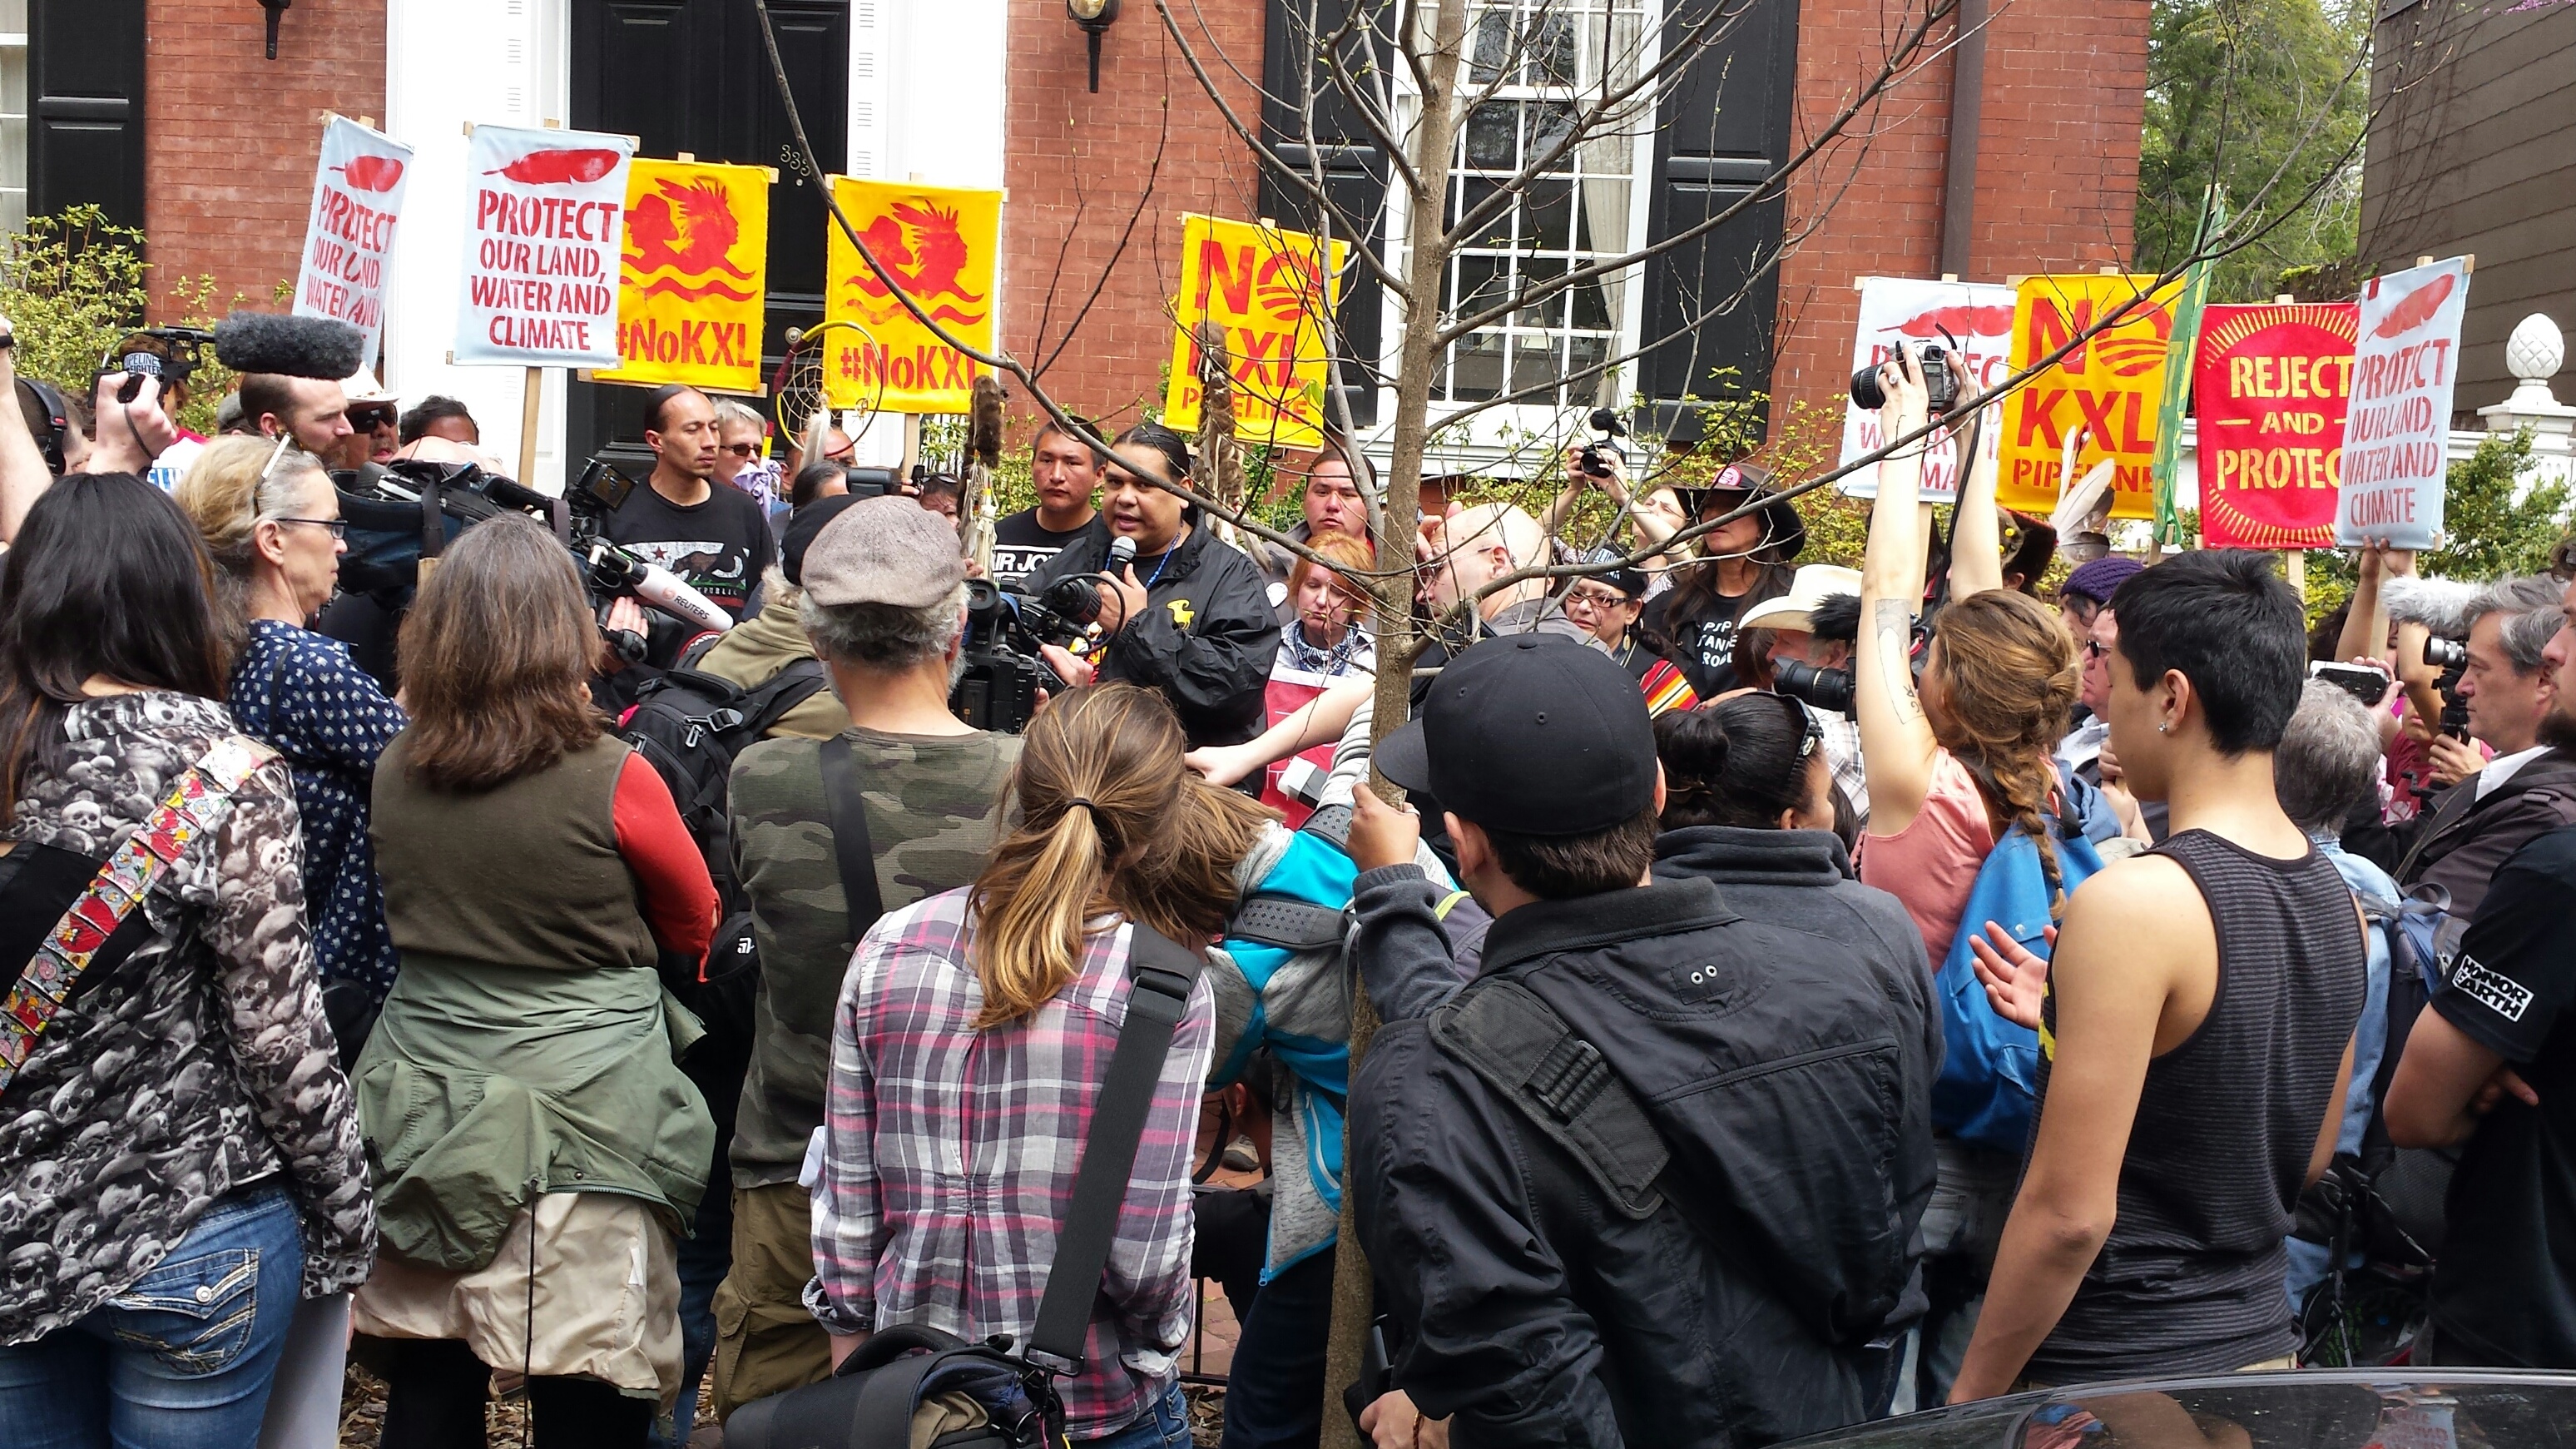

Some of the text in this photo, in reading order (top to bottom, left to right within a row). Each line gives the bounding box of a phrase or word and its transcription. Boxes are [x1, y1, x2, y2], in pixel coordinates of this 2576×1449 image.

[478, 189, 618, 243] PROTECT
[314, 236, 343, 276] OUR
[480, 239, 606, 284] OUR LAND,
[306, 275, 380, 328] WATER AND
[471, 275, 610, 315] WATER AND
[1195, 240, 1321, 321] NO
[489, 315, 591, 350] CLIMATE
[2029, 298, 2172, 377] NO
[2230, 355, 2355, 398] REJECT
[2358, 339, 2450, 400] PROTECT
[2017, 388, 2153, 454] KXL
[2259, 412, 2325, 434] AND
[2351, 396, 2436, 444] OUR LAND,
[2344, 442, 2438, 486] WATER AND
[2350, 488, 2415, 527] CLIMATE
[674, 596, 710, 620] REUTERS
[2464, 958, 2528, 1005] HONOR
